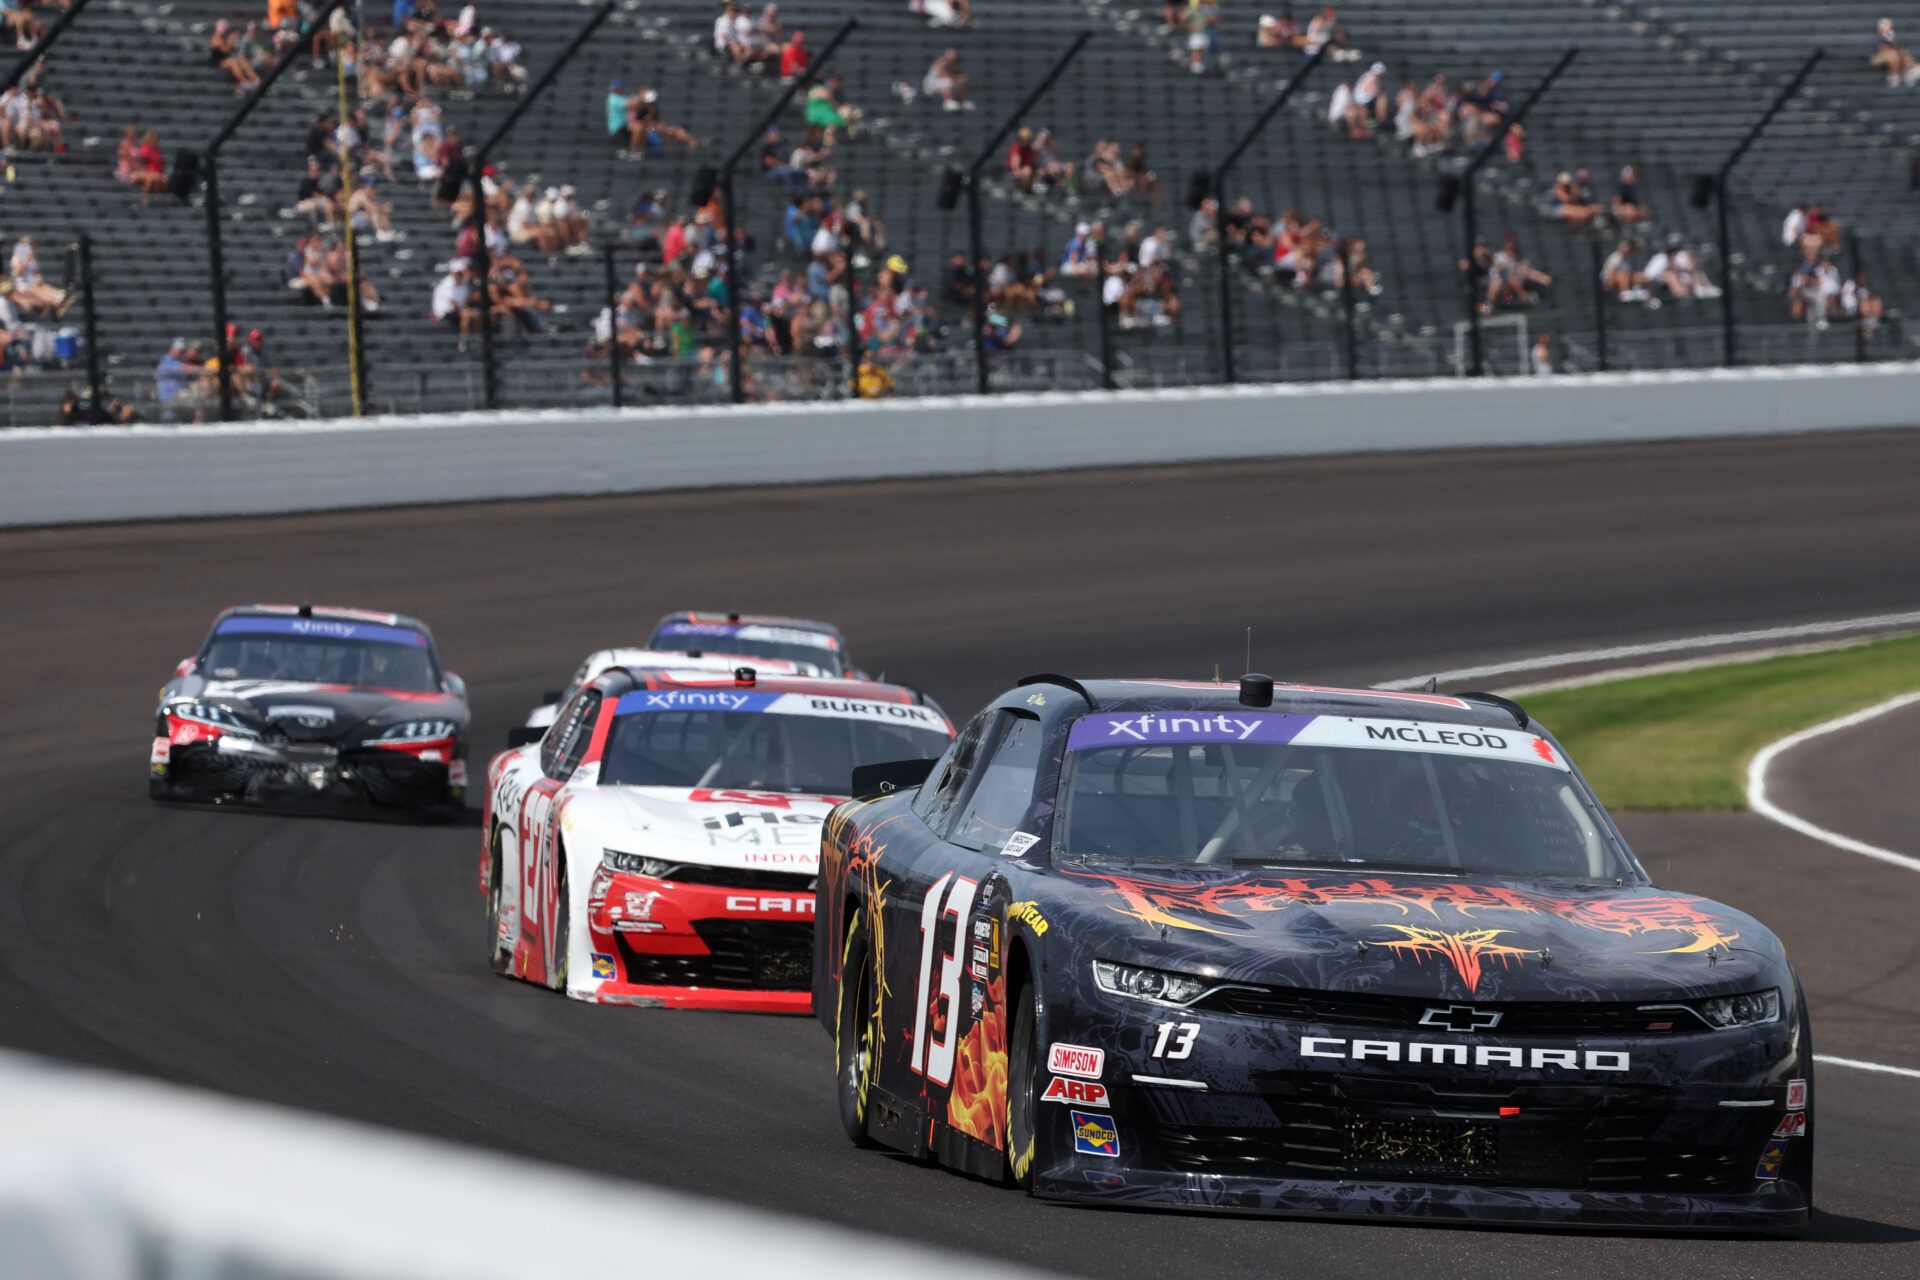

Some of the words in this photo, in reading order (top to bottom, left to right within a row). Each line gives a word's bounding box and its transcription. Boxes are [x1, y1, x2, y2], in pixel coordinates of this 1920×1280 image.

[646, 690, 749, 710] xfinity
[811, 698, 929, 722] BURTON
[1108, 714, 1263, 740] xfinity
[1365, 725, 1508, 750] MCLEOD
[910, 870, 978, 1088] 13
[1152, 1021, 1201, 1060] 13
[1053, 1048, 1099, 1073] SIMPSON
[1300, 1036, 1631, 1072] CAMARO
[1046, 1077, 1105, 1103] ARP
[1078, 1127, 1115, 1142] SUNOCO
